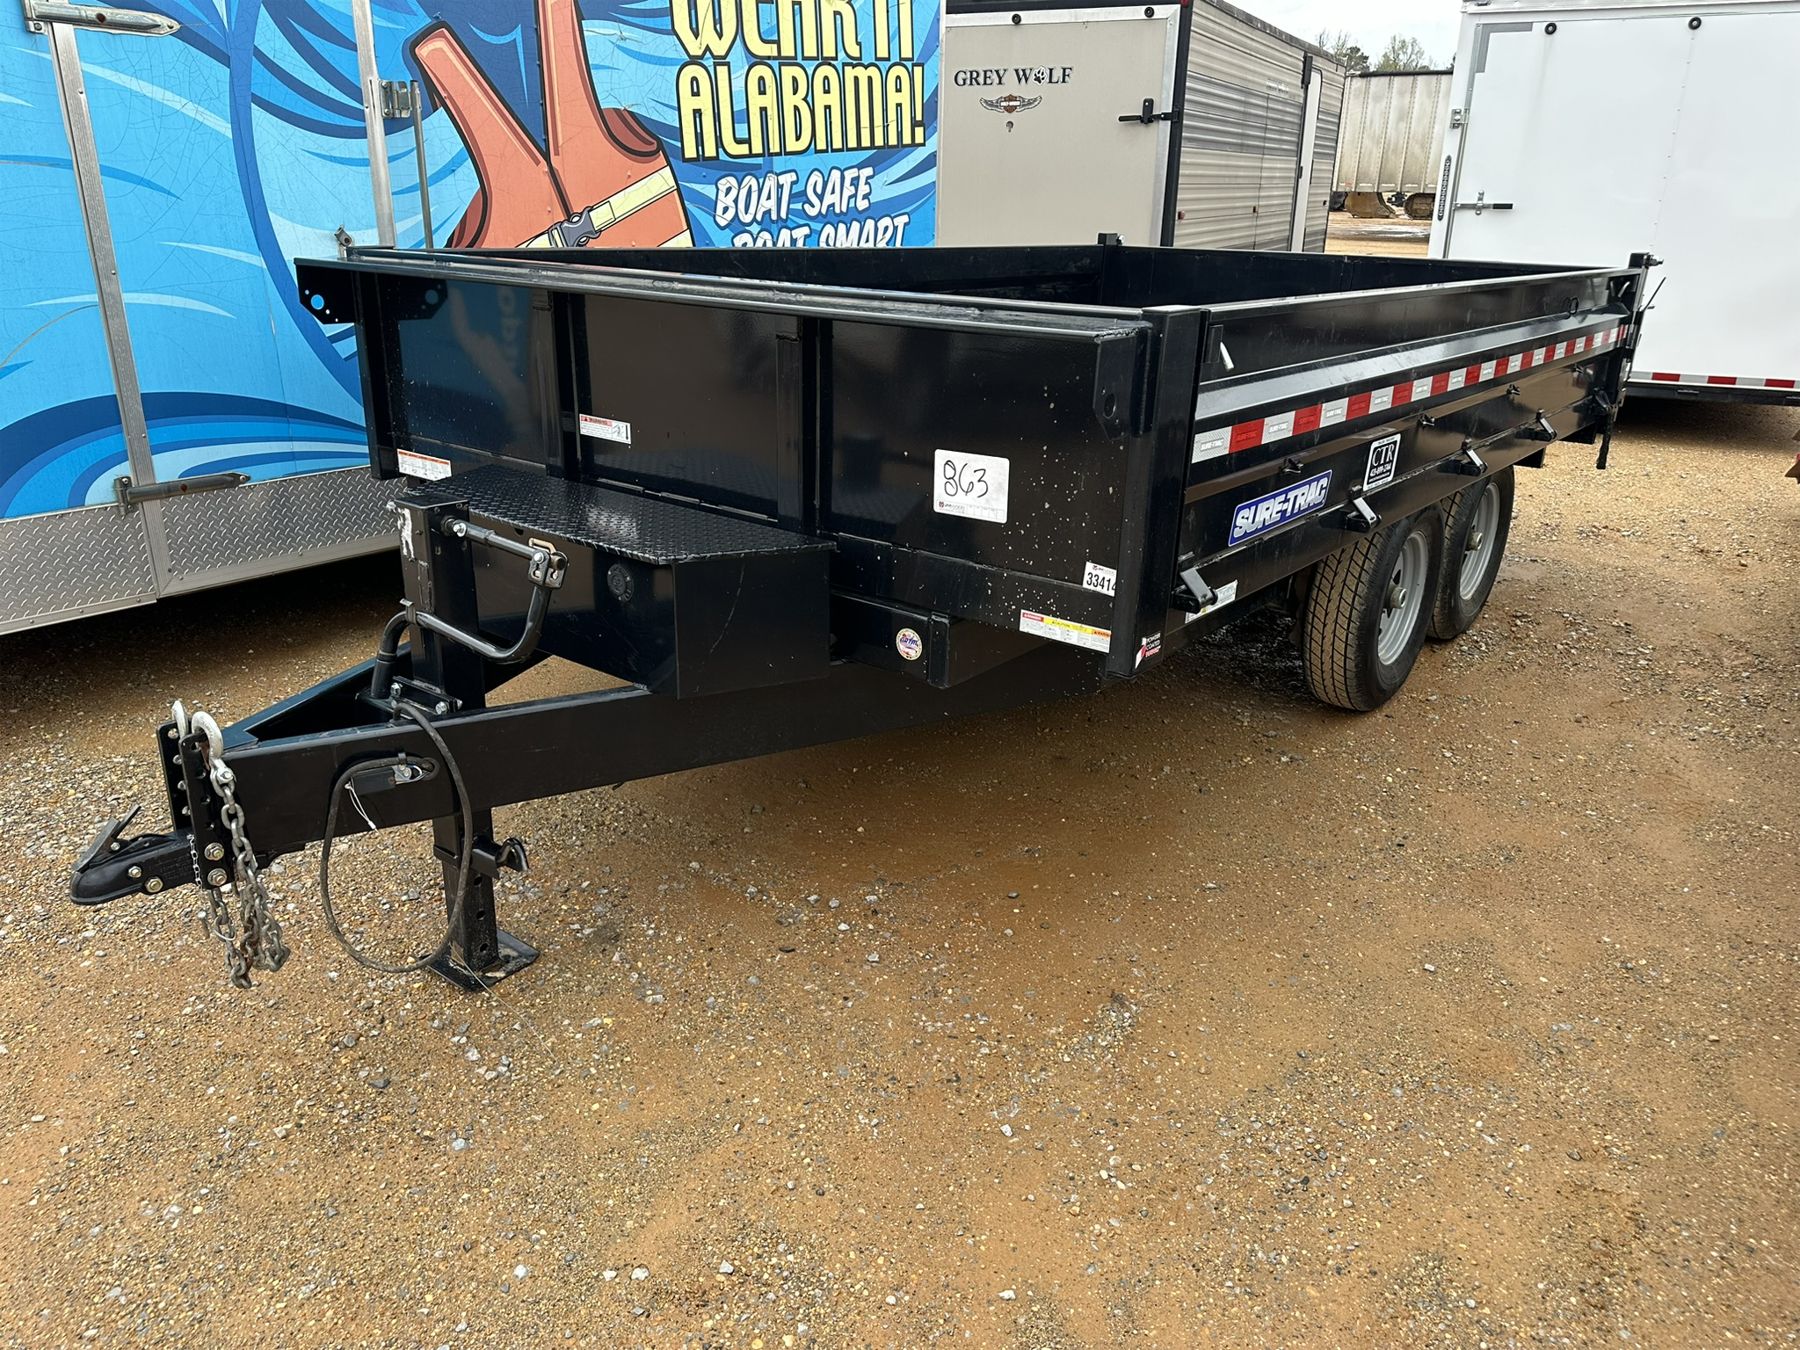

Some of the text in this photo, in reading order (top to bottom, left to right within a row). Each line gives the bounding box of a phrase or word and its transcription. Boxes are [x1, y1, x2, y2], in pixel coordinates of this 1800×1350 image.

[954, 68, 1008, 86] GREY
[676, 60, 926, 162] ALABAMA!
[714, 166, 874, 228] BOAT SAFE
[732, 213, 910, 248] AT SMART
[1371, 443, 1395, 466] CTR
[943, 459, 989, 498] 863
[1233, 477, 1328, 538] SURE-TRAC
